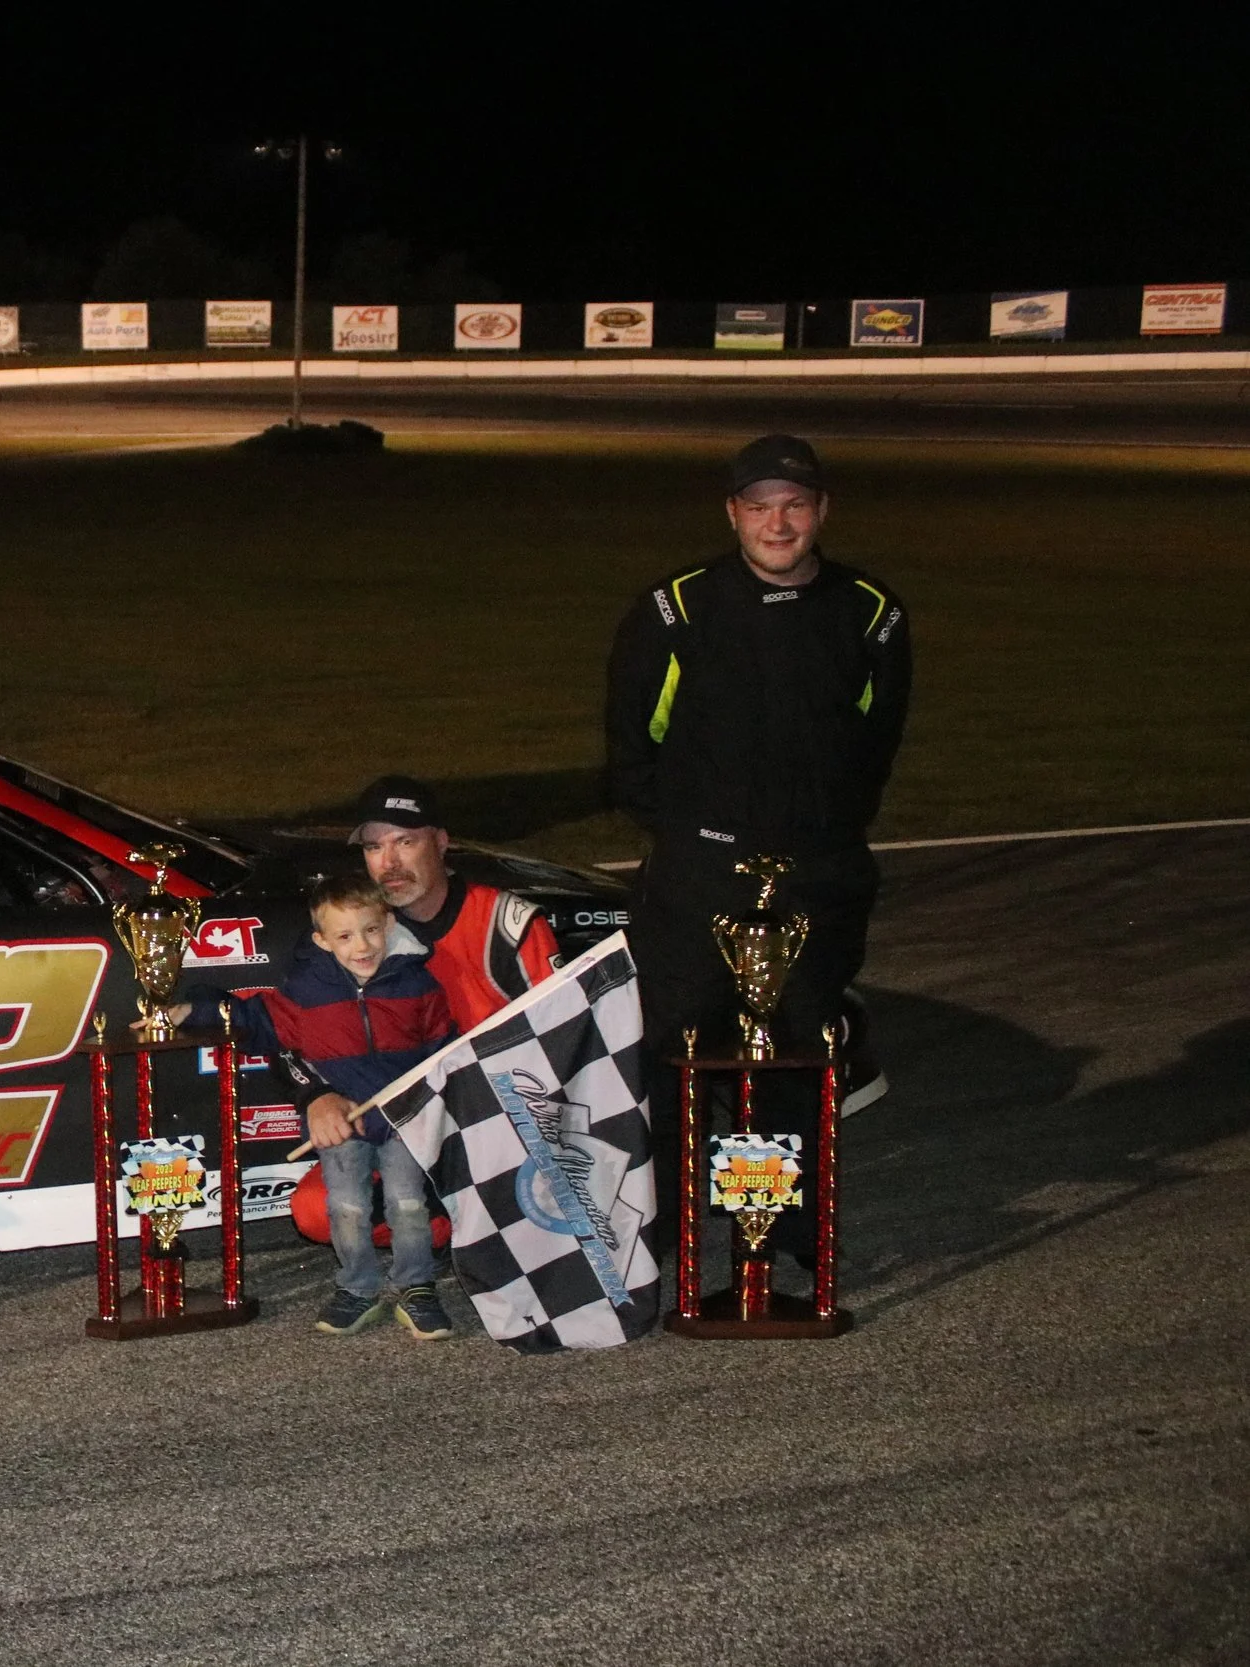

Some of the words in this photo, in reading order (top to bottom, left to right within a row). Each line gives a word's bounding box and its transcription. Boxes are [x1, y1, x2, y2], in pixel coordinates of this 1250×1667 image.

[1145, 293, 1222, 305] CENTRAL
[862, 315, 912, 326] SUNOCO
[86, 327, 113, 335] Auto
[115, 325, 145, 336] Parts
[762, 590, 799, 604] sparco
[653, 588, 676, 626] sparco
[699, 828, 735, 843] sparco
[253, 1109, 297, 1119] Longacre
[155, 1164, 174, 1175] 2023
[747, 1161, 766, 1172] 2023
[132, 1178, 150, 1193] LEAF
[151, 1174, 182, 1190] PEEPERS
[184, 1173, 198, 1186] 100
[721, 1175, 739, 1188] LEAF
[741, 1175, 775, 1188] PEEPERS
[777, 1175, 791, 1188] 100
[130, 1190, 203, 1209] WINNER
[714, 1192, 748, 1205] 2ND
[751, 1192, 800, 1205] PLACE
[580, 1238, 636, 1309] PARK
